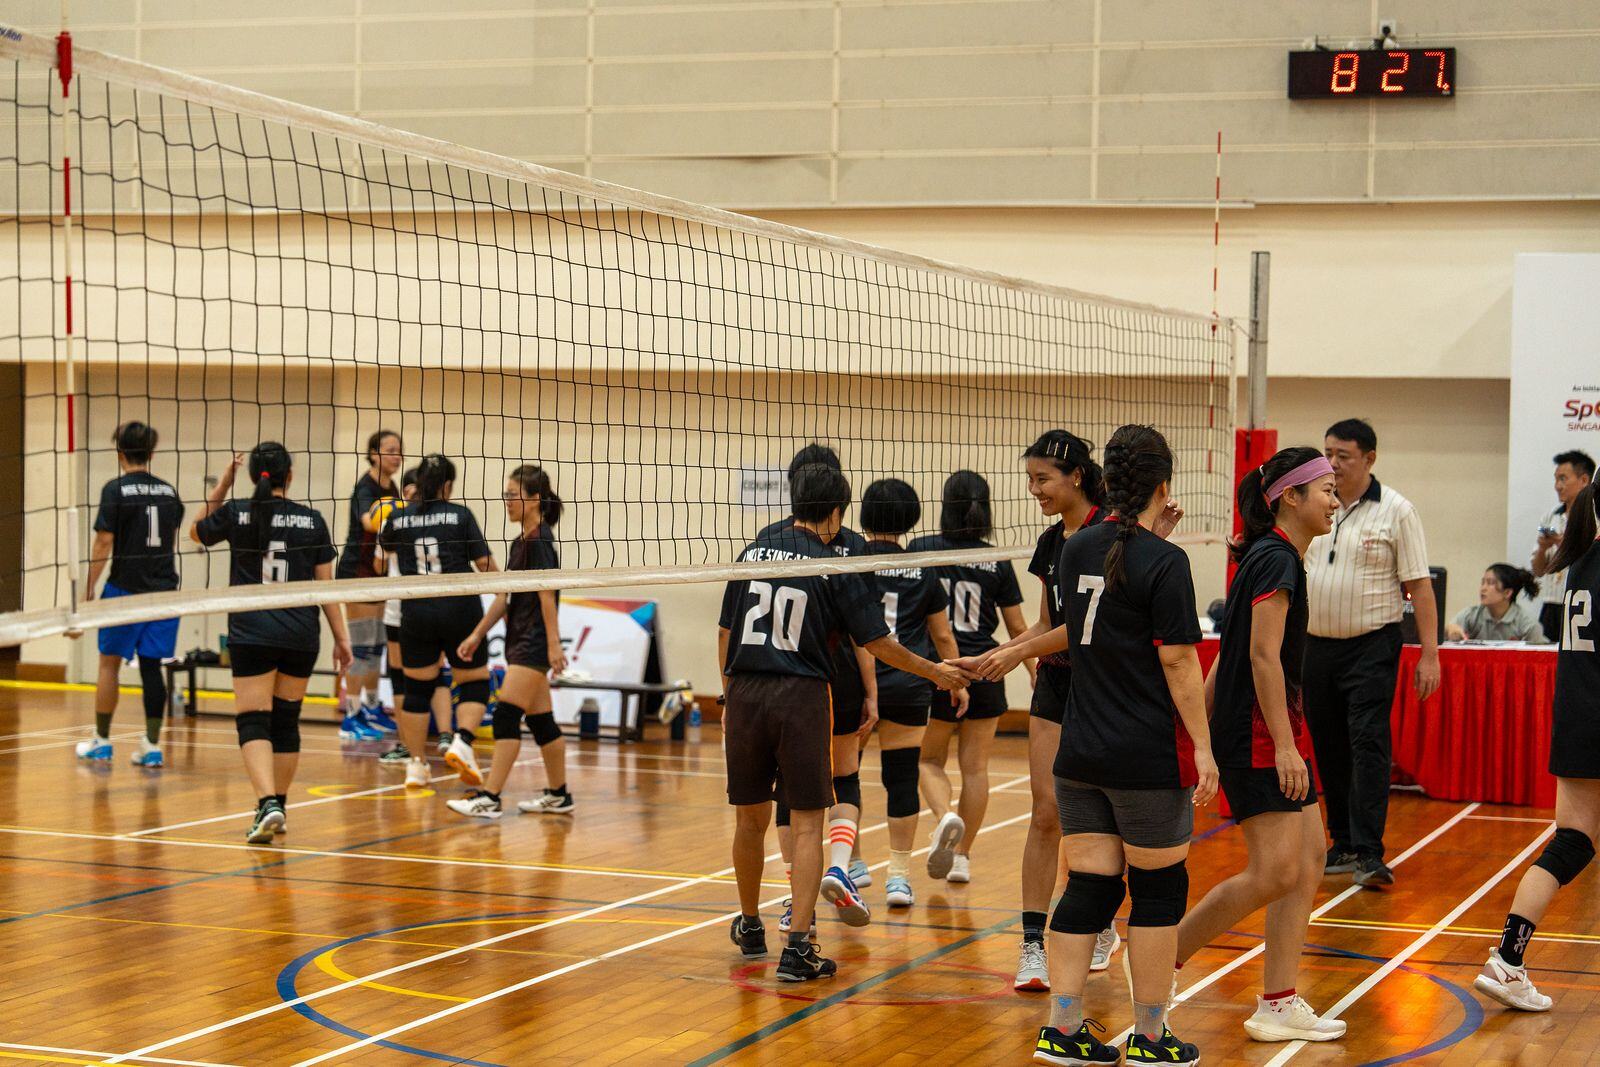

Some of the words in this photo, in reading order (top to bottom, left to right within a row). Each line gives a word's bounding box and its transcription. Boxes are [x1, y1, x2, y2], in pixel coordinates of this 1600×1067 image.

[1331, 53, 1359, 93] 8
[1568, 422, 1600, 431] SINGA
[145, 505, 161, 547] 1
[262, 541, 288, 584] 6
[741, 580, 808, 652] 20
[1077, 574, 1106, 645] 7
[1562, 589, 1596, 652] 12
